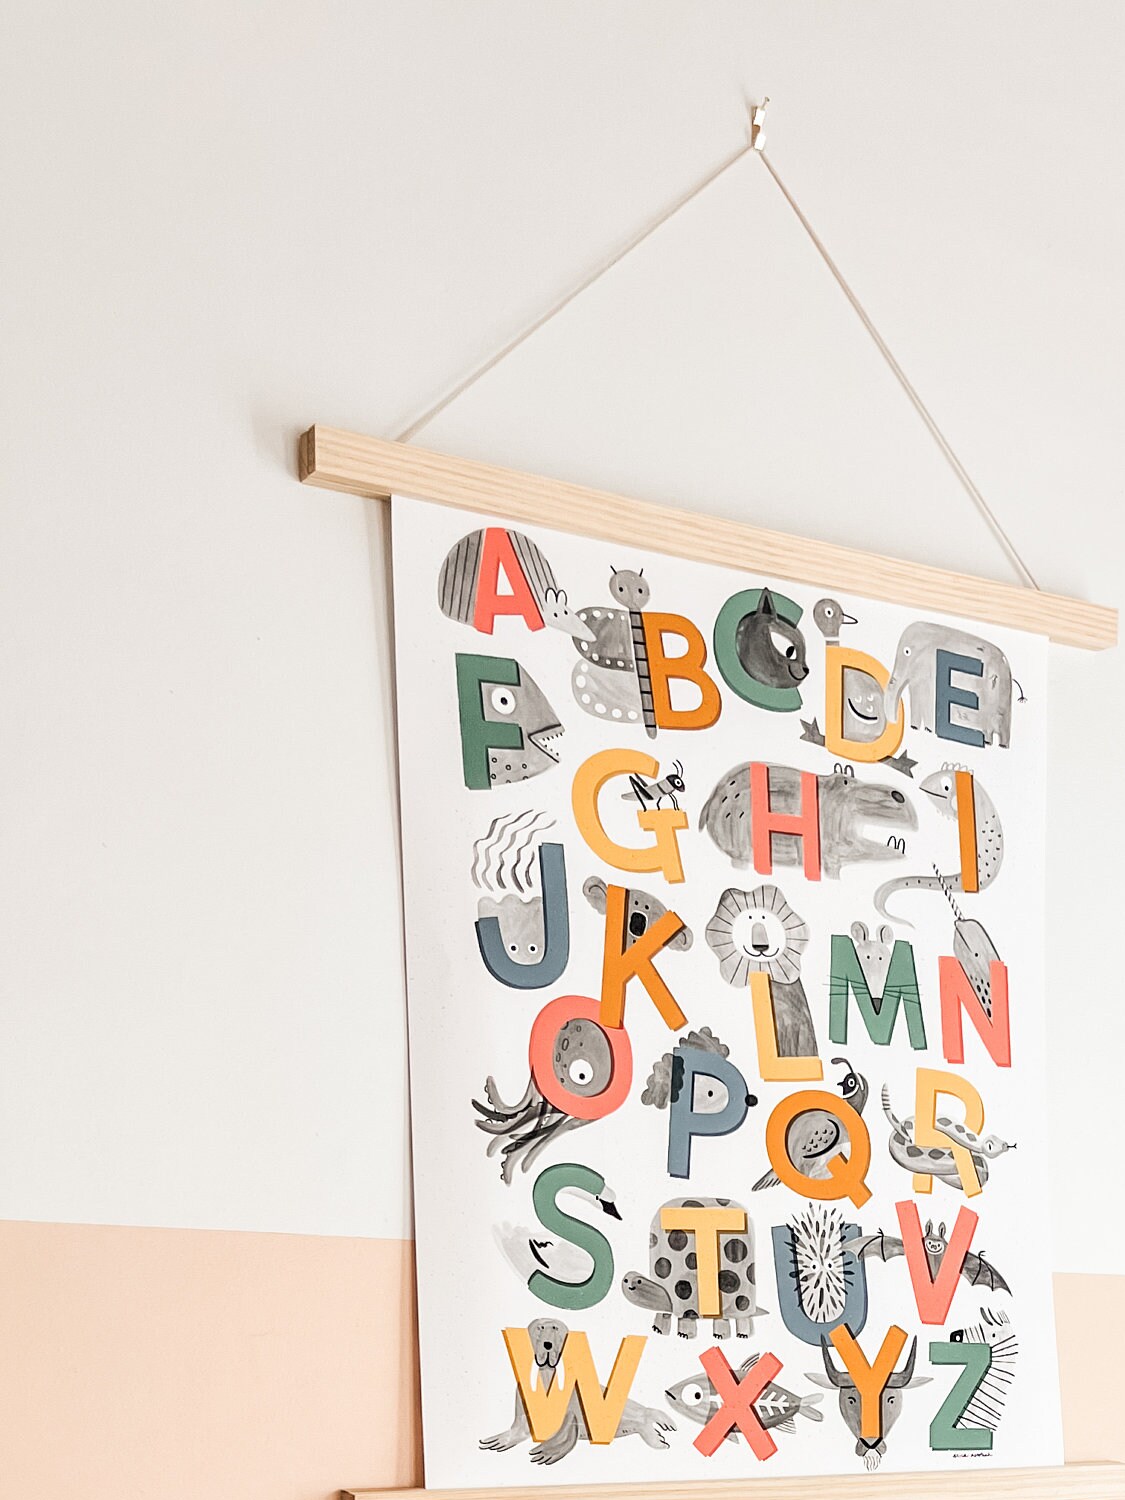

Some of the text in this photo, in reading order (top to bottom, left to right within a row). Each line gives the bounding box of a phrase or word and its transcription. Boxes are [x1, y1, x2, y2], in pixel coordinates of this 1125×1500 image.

[473, 527, 985, 762] A B C D E
[455, 653, 980, 893] F G H I
[474, 842, 1012, 1082] J K L M N
[529, 995, 985, 1209] O P Q R
[527, 1162, 979, 1347] S T U V
[502, 1323, 994, 1461] W X Y Z
